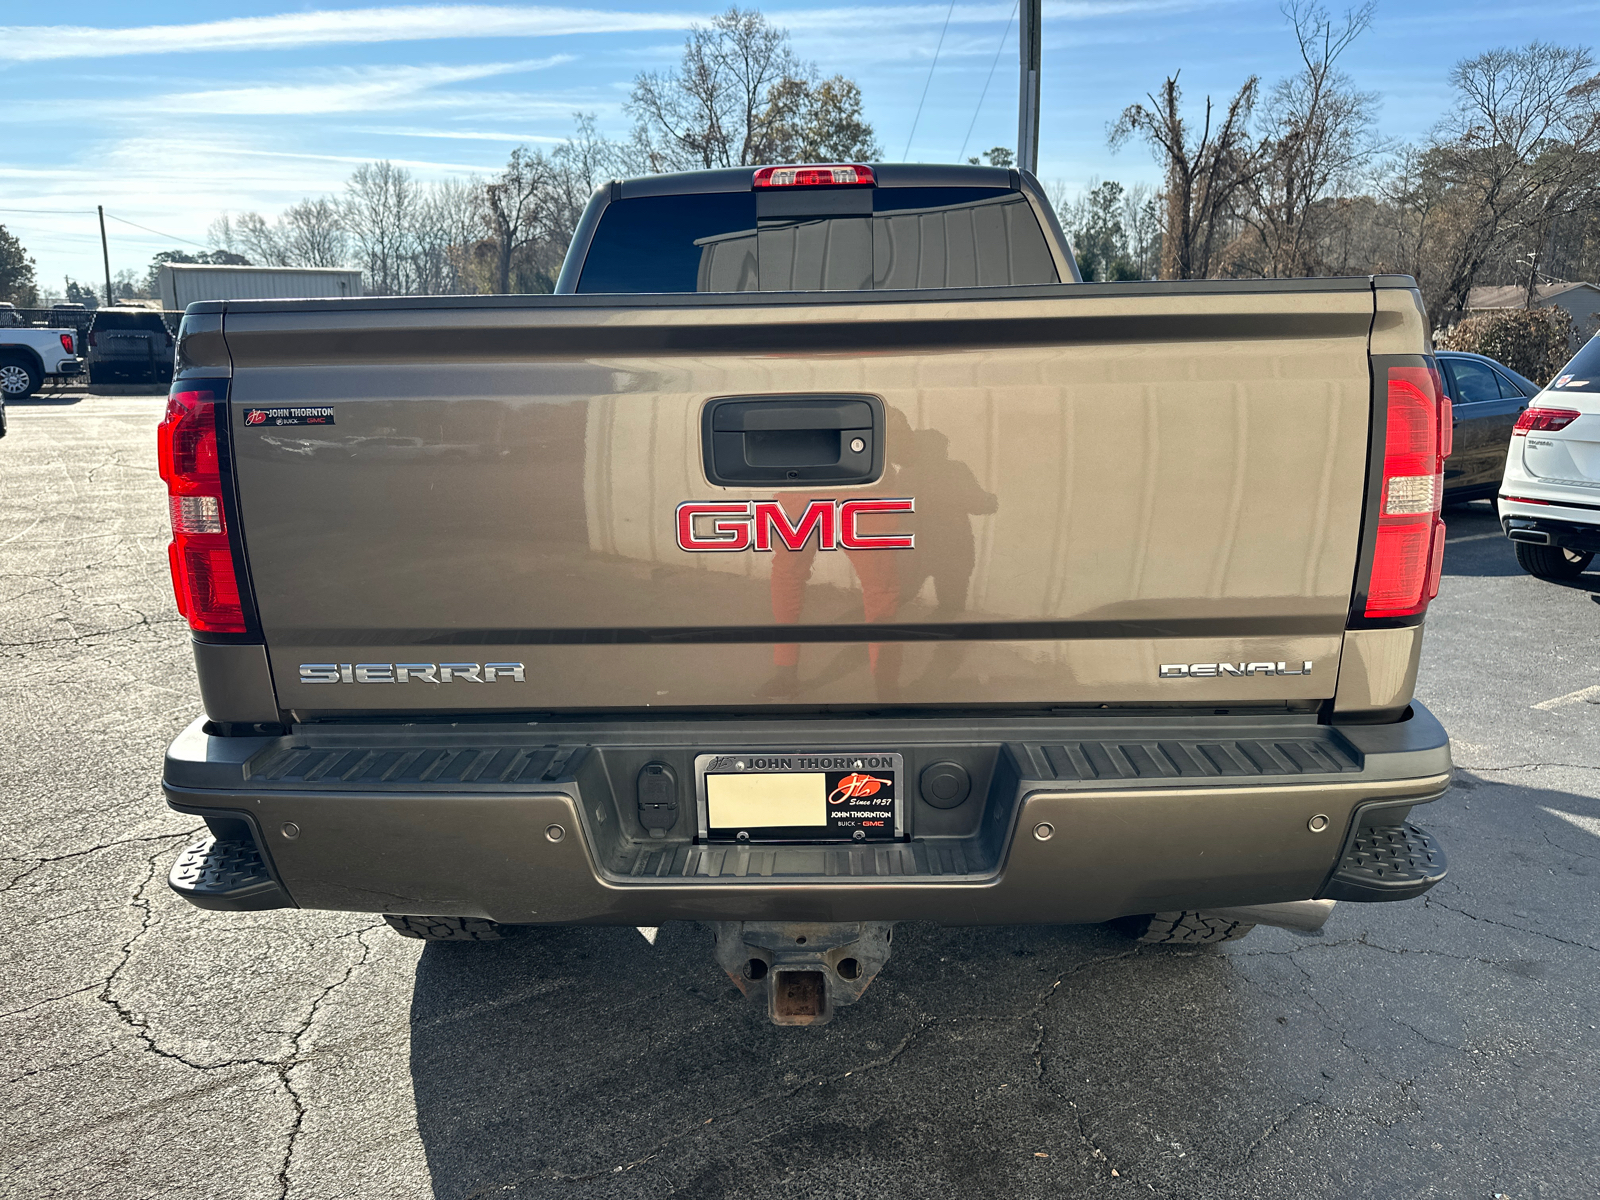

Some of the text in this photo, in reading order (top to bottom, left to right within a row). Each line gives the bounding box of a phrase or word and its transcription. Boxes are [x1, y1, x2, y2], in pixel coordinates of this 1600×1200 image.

[269, 407, 333, 417] JOHN THORNTON
[676, 498, 915, 551] GMC
[299, 662, 526, 683] SIERRA
[1159, 661, 1313, 678] DENALI
[747, 758, 792, 770] JOHN
[798, 757, 893, 769] THORNTON
